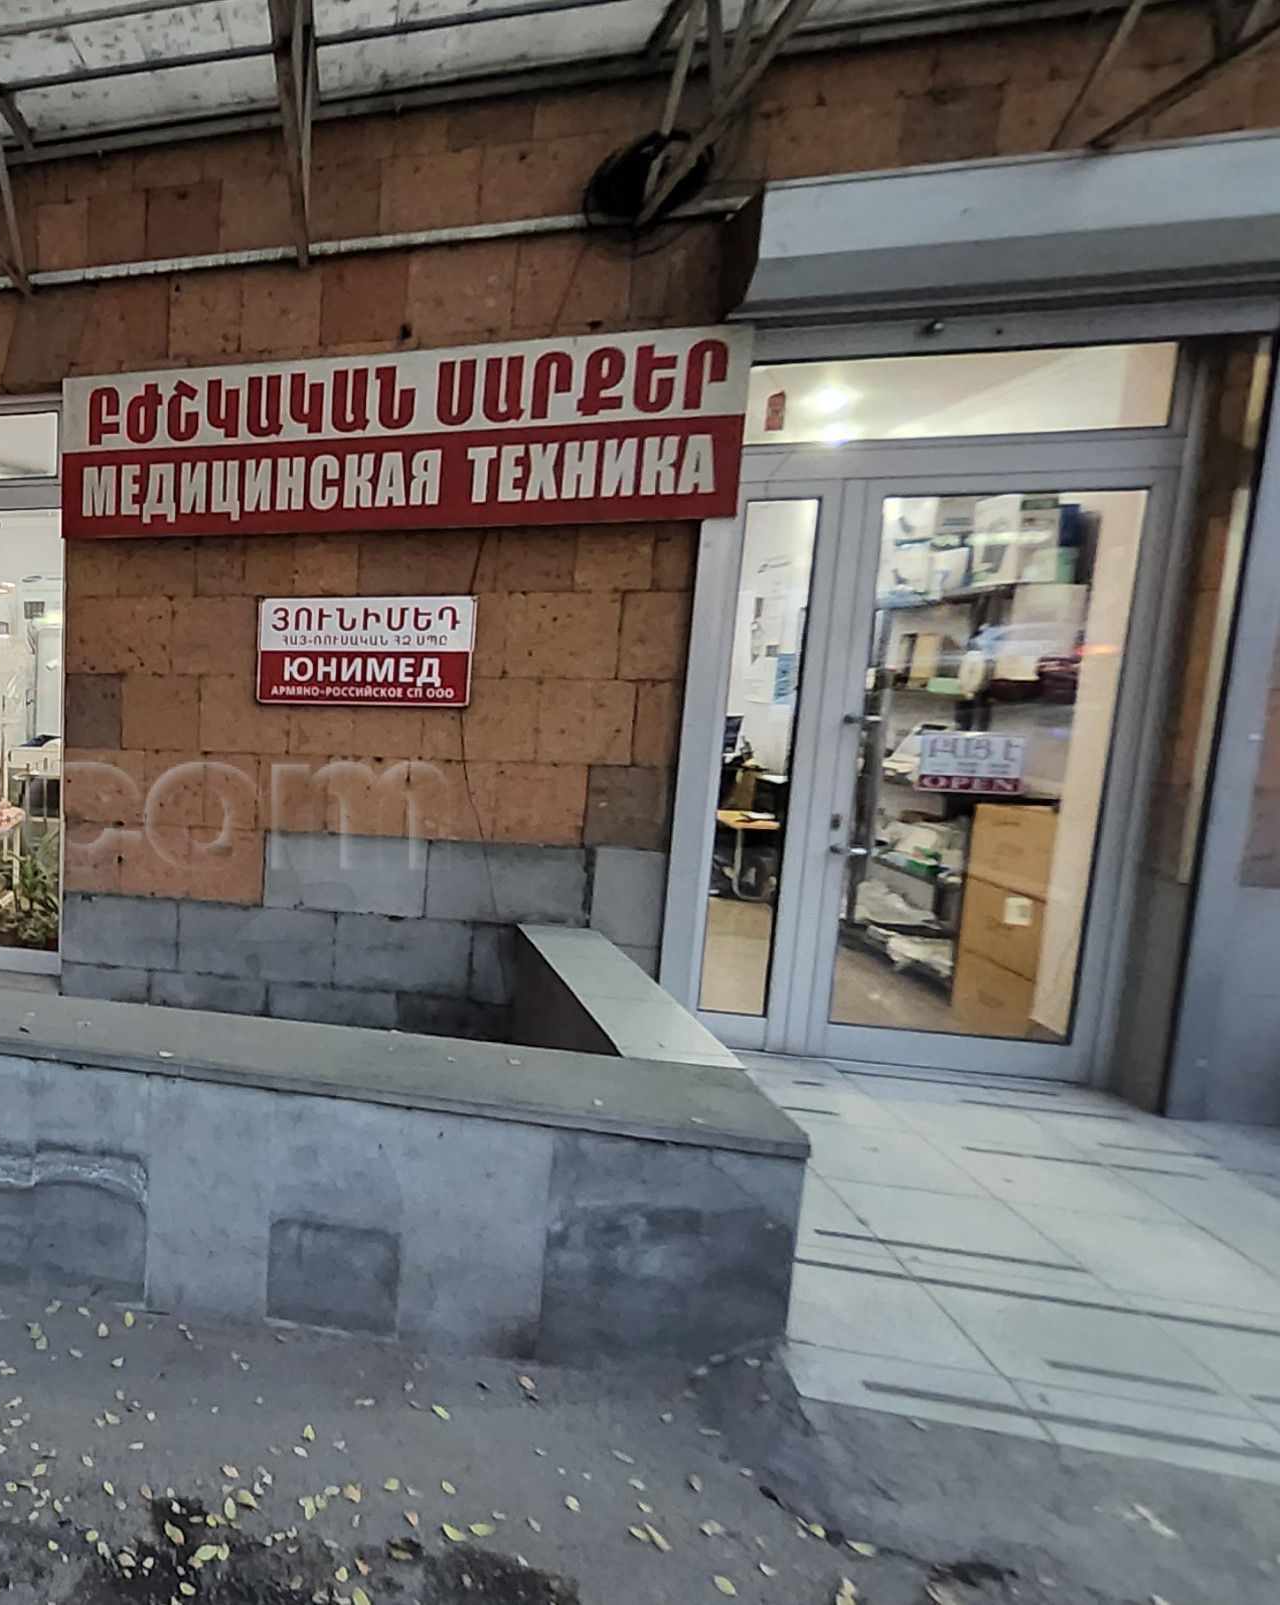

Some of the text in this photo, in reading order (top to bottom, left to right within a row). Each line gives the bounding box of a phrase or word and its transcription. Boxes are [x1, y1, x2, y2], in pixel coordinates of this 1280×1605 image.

[87, 337, 728, 446] ԲԺՇԿԱԿԱՆ ՍԱՐՔԵՐ
[81, 433, 716, 524] МЕДИЦИНСКАЯ ТЕХНИКА
[271, 606, 460, 631] ՅՈՒՆԻՄԵԴ
[416, 635, 448, 646] ՍՊԸ
[283, 656, 442, 687] ЮНИМЕД
[270, 685, 404, 699] АРМЯНО-РОССИЙСКОЕ
[406, 686, 422, 699] СП
[921, 776, 1017, 791] OPEN
